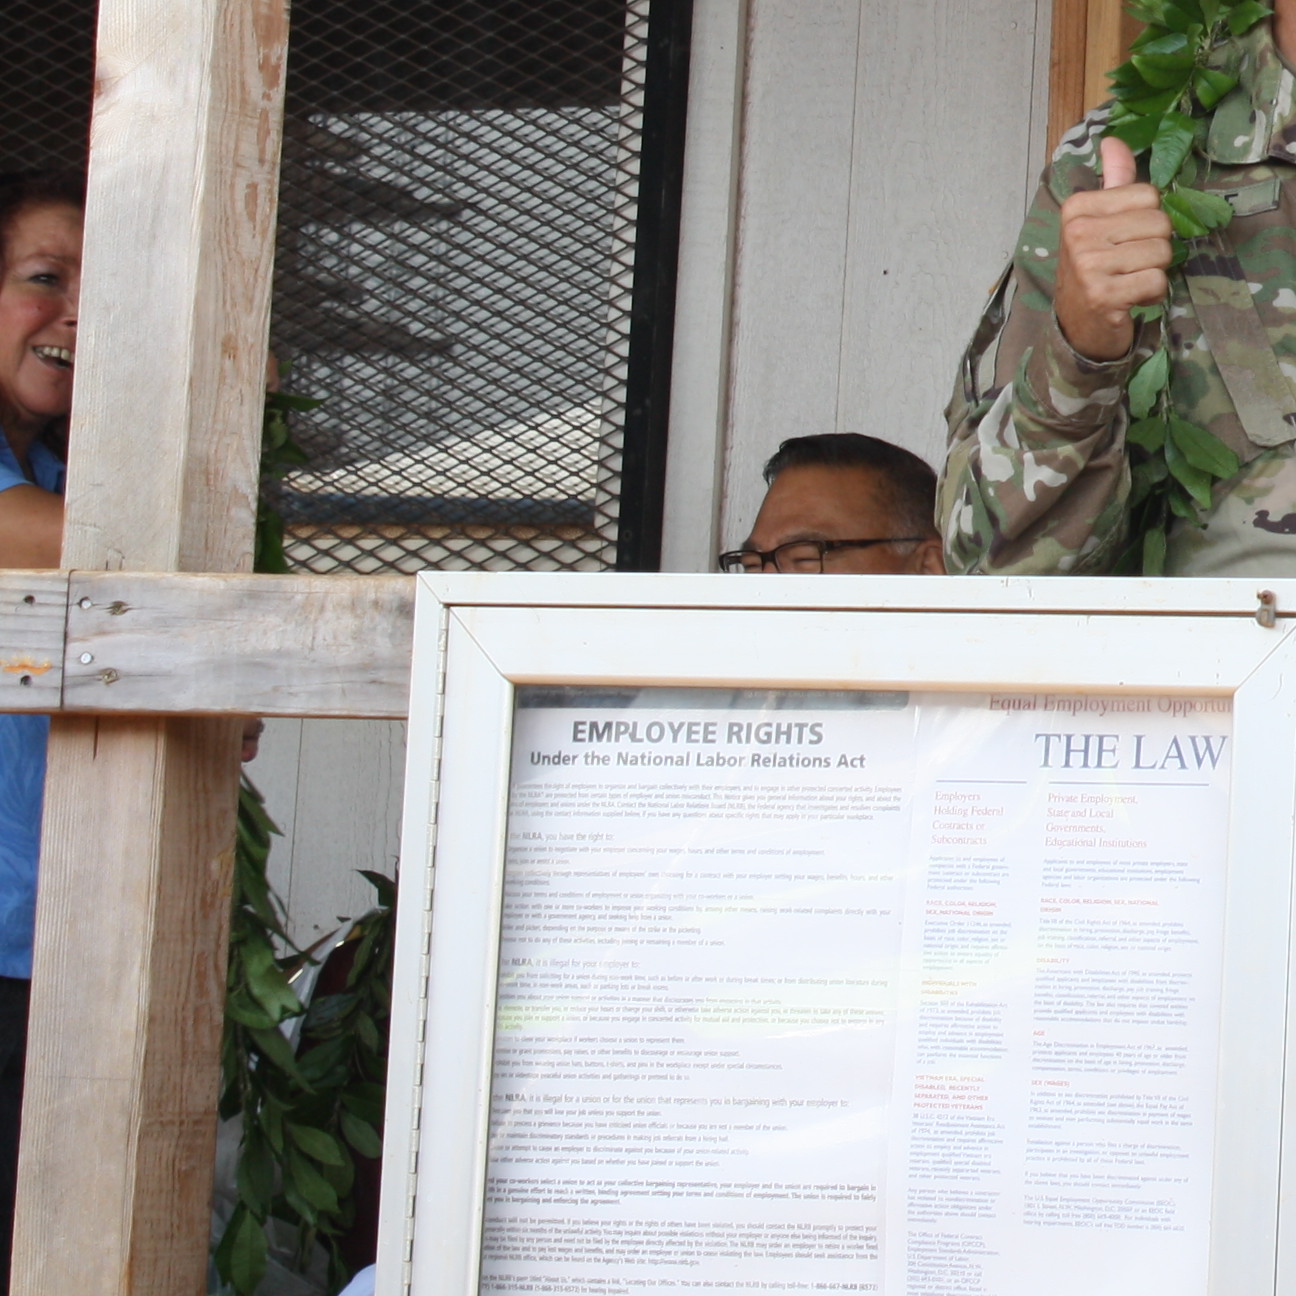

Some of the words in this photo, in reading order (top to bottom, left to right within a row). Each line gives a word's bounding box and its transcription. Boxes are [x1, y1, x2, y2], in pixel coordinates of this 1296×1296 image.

[1043, 695, 1153, 717] Employment
[571, 720, 716, 743] EMPLOYEE
[726, 721, 823, 745] RIGHTS
[1033, 732, 1121, 770] THE
[1131, 734, 1228, 771] LAW
[530, 750, 577, 765] Under
[583, 750, 610, 766] the
[616, 750, 690, 766] National
[695, 751, 743, 767] Labor
[750, 752, 831, 768] Relations
[836, 753, 865, 768] Act
[934, 791, 981, 803] Employers
[1047, 792, 1078, 803] Private
[1080, 793, 1138, 806] Employment,
[933, 805, 969, 817] Holding
[970, 805, 1004, 816] Federal
[1046, 807, 1070, 820] State
[1070, 807, 1087, 817] and
[1088, 807, 1114, 818] Local
[931, 820, 974, 830] Contracts
[1045, 822, 1106, 833] Governments,
[930, 834, 987, 844] Subcontracts
[1044, 836, 1096, 850] Educational
[1098, 837, 1147, 848] Institutions
